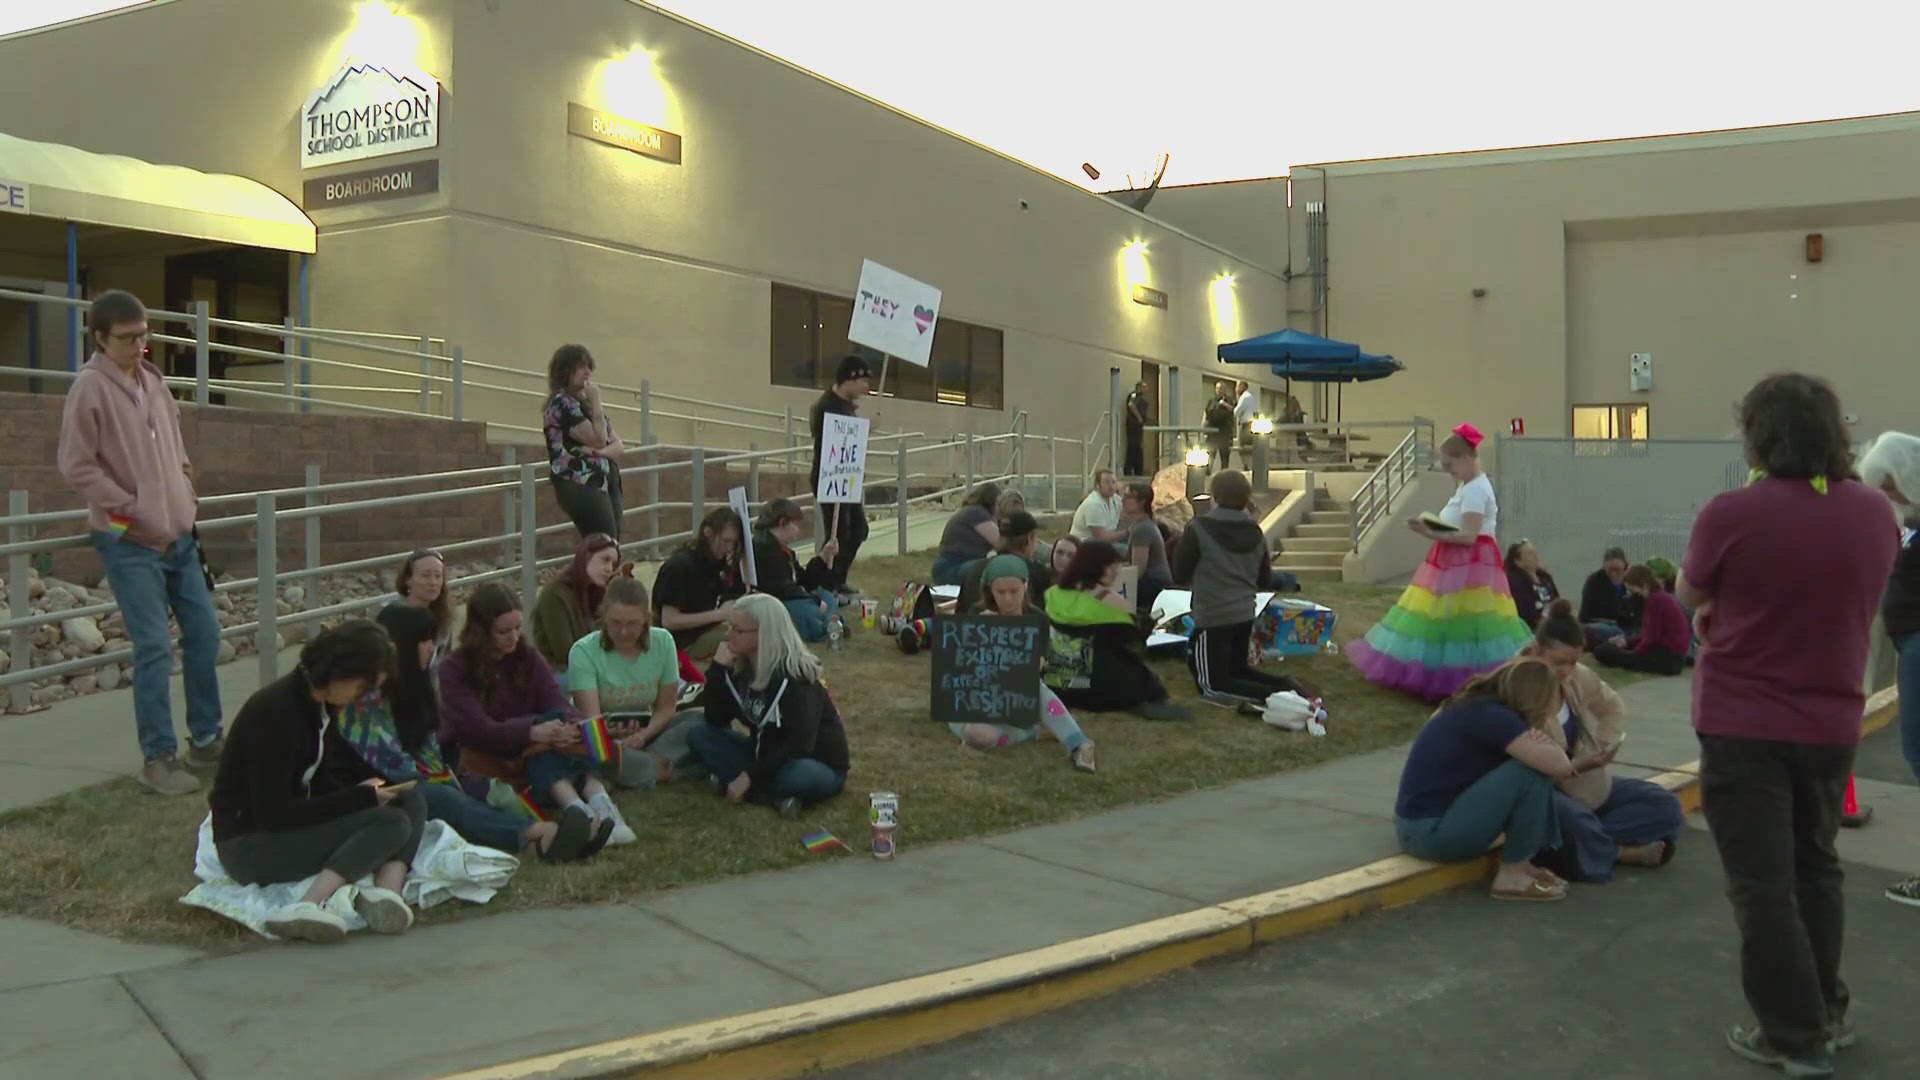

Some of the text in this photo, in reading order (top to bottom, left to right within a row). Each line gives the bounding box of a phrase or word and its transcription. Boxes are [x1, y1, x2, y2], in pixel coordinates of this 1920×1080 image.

[307, 94, 431, 138] THOMPSON
[308, 120, 431, 156] SCHOOL DISTRICT
[326, 171, 412, 200] BOARDROOM
[942, 621, 1039, 650] RESPECT
